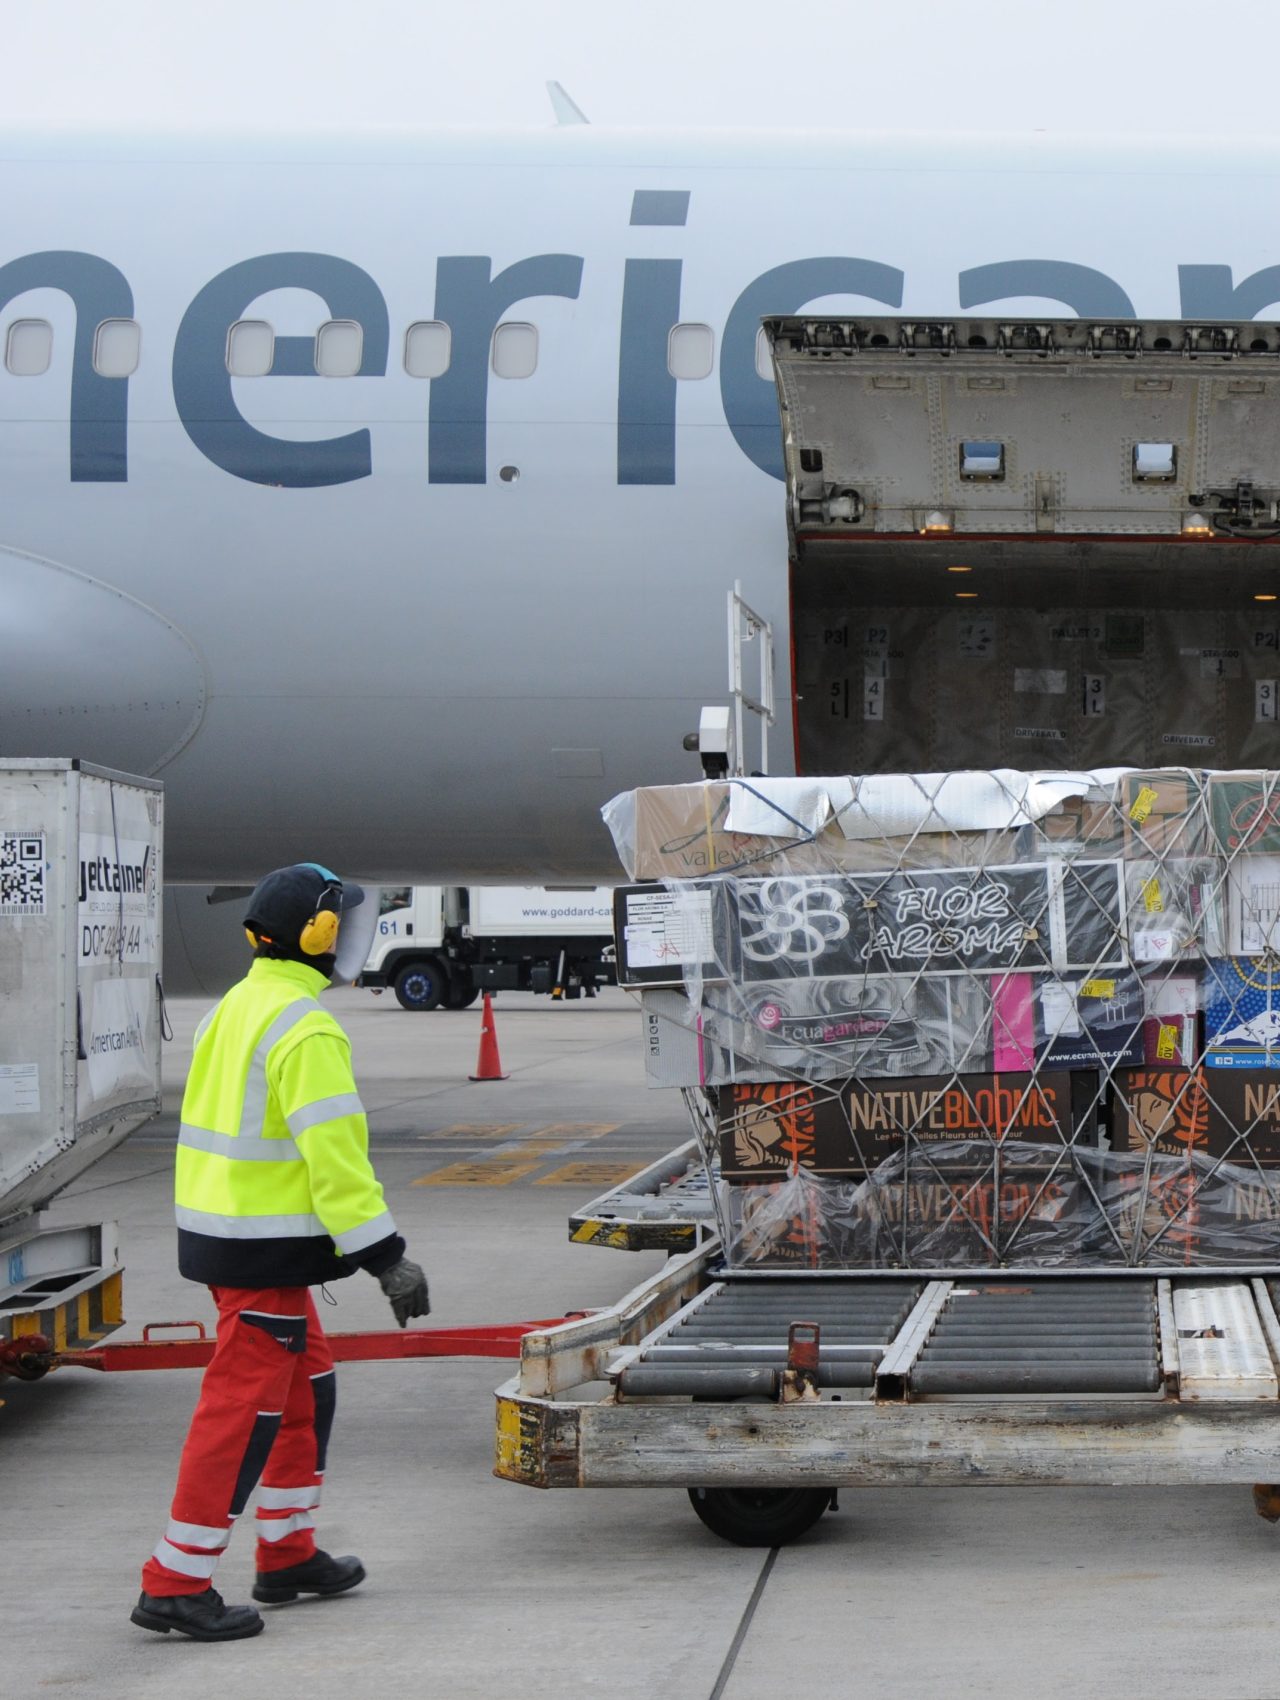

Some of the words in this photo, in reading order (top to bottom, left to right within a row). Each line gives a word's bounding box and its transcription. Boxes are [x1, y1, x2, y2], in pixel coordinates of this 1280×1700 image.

[824, 629, 843, 645] P3
[868, 627, 887, 643] P2
[1254, 632, 1274, 647] P2
[1091, 679, 1101, 694] 3
[1260, 685, 1270, 699] 3
[1261, 703, 1269, 717] L
[896, 883, 1009, 923] FLOR
[379, 921, 398, 936] 61
[860, 924, 1027, 959] AROMA
[781, 1017, 886, 1043] Ecuagarden
[1047, 1050, 1132, 1061] www.ecuanos.com
[940, 1130, 966, 1139] Fleurs
[967, 1130, 979, 1139] de
